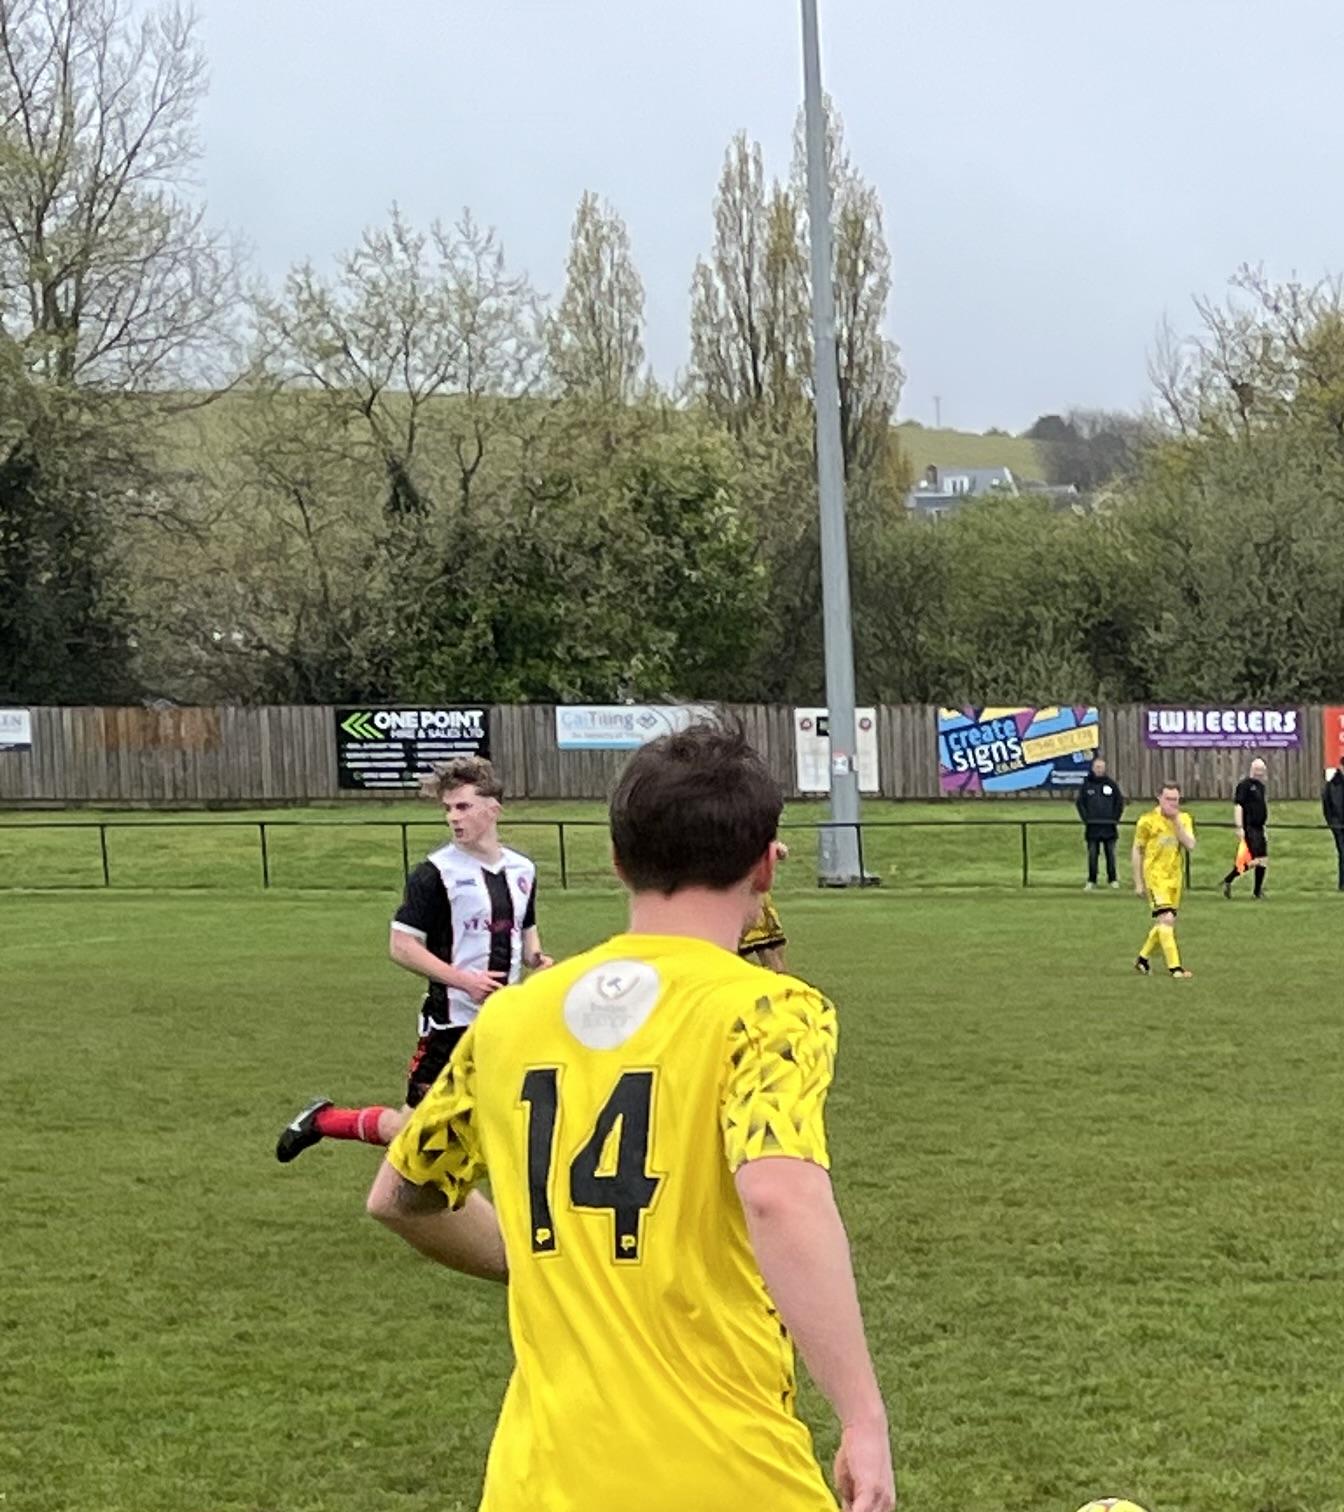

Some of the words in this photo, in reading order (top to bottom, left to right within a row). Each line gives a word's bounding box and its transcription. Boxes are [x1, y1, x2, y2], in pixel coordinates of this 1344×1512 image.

[373, 711, 419, 729] ONE
[420, 710, 484, 729] POINT
[948, 719, 1017, 750] create
[1159, 710, 1297, 733] WHEELERS
[952, 737, 1023, 773] signs
[517, 1065, 664, 1261] 14
